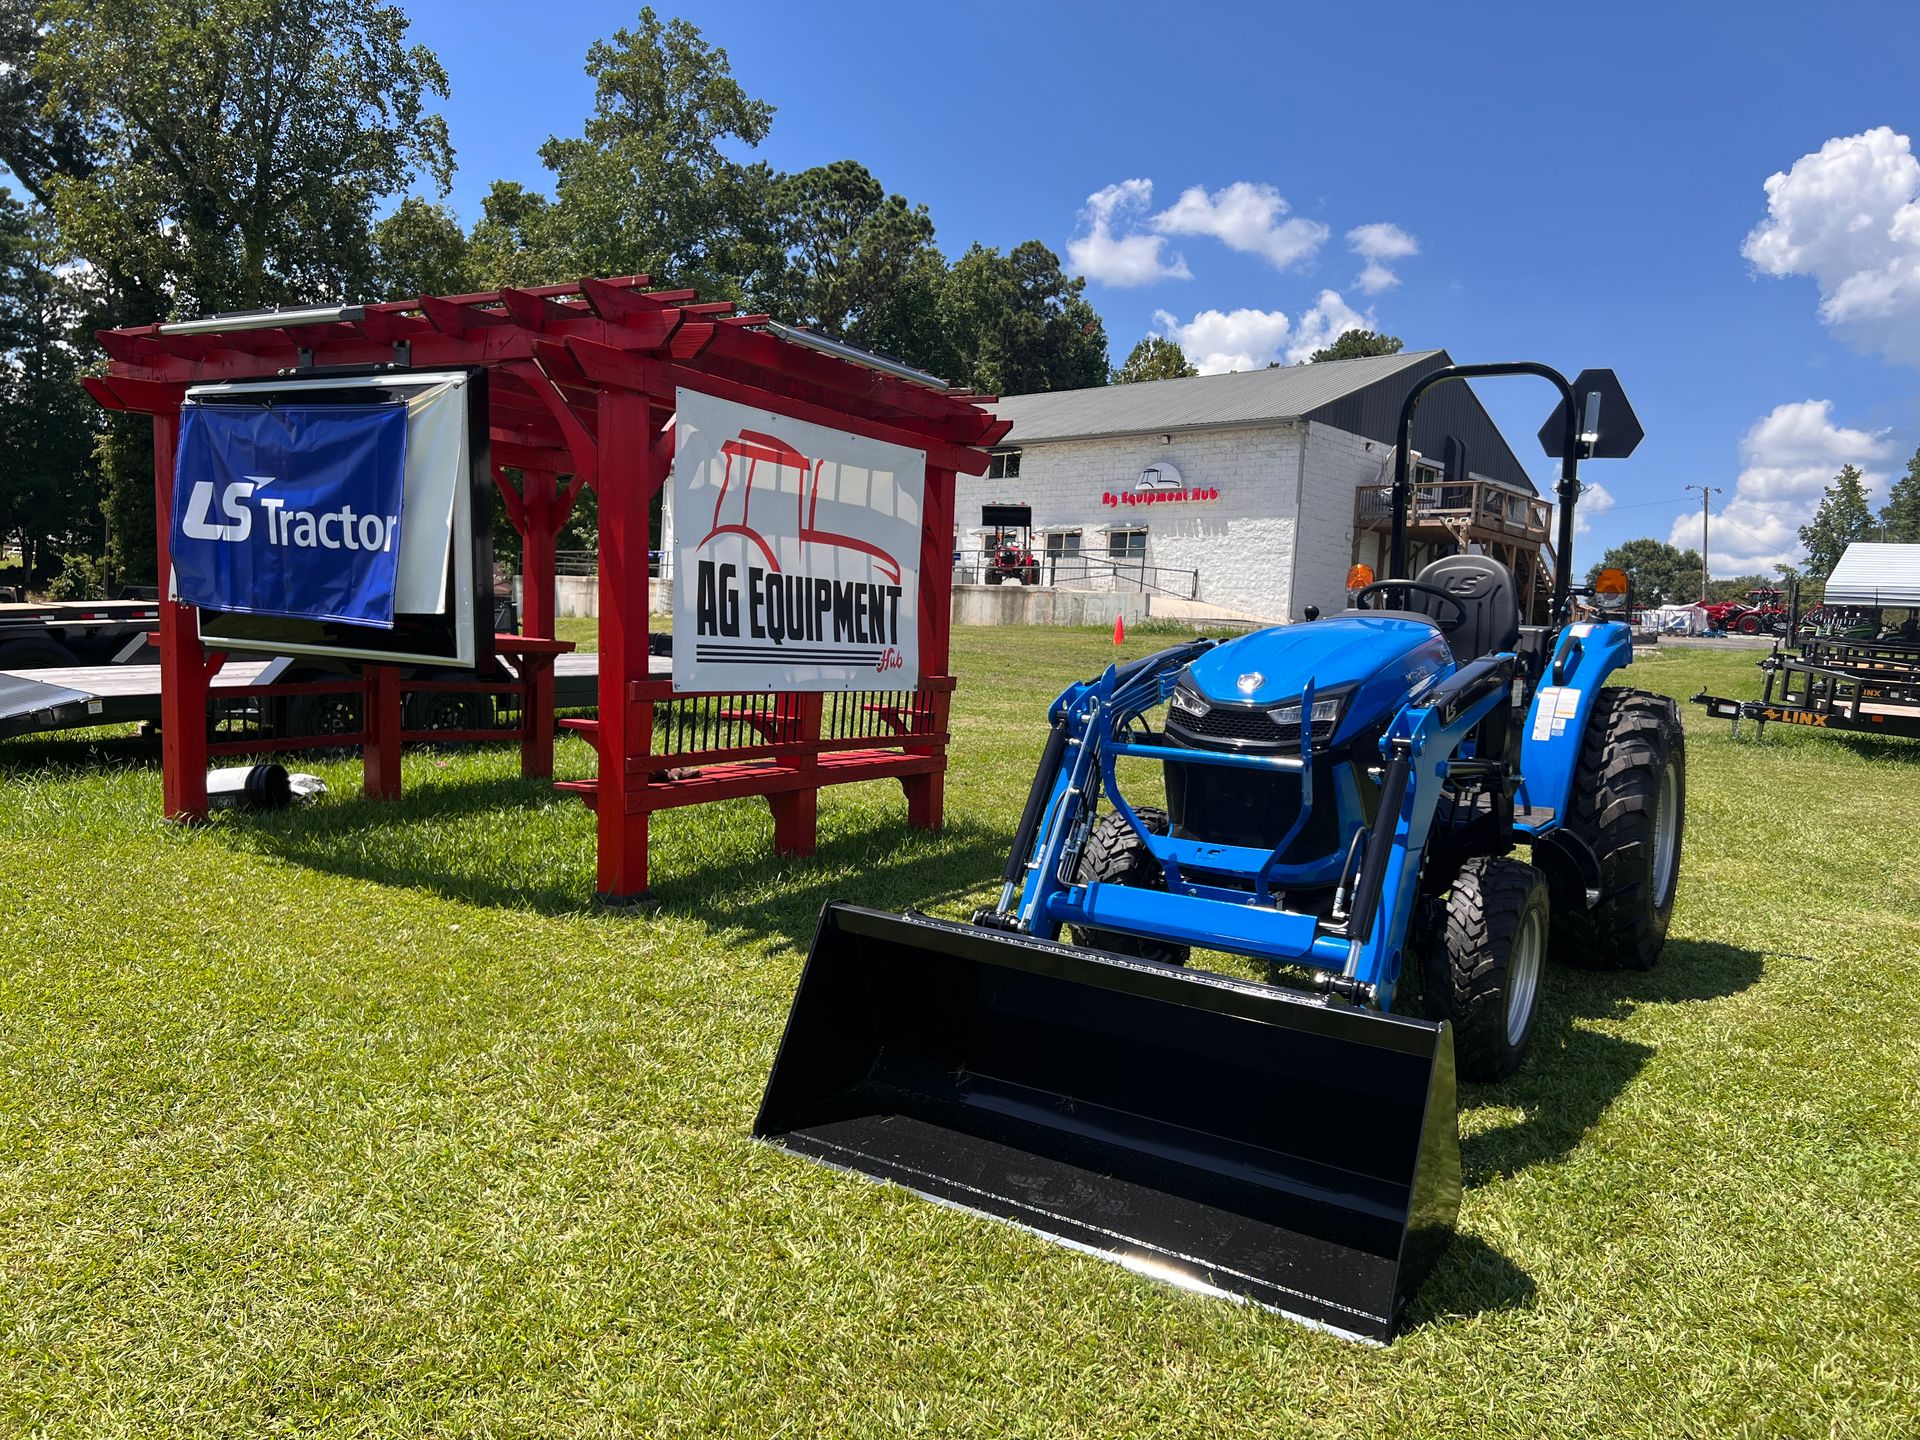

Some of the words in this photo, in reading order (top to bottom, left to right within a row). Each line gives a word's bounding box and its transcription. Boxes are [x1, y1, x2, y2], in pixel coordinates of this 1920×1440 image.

[1102, 491, 1118, 508] Ag
[1121, 487, 1189, 507] Equipment
[1192, 487, 1219, 501] Hub
[181, 480, 256, 542] LS
[260, 497, 398, 553] Tractor
[696, 559, 741, 638] AG
[748, 566, 903, 646] EQUIPMENT
[876, 647, 903, 673] Hub
[1862, 688, 1882, 698] INX
[1781, 709, 1830, 728] LINX
